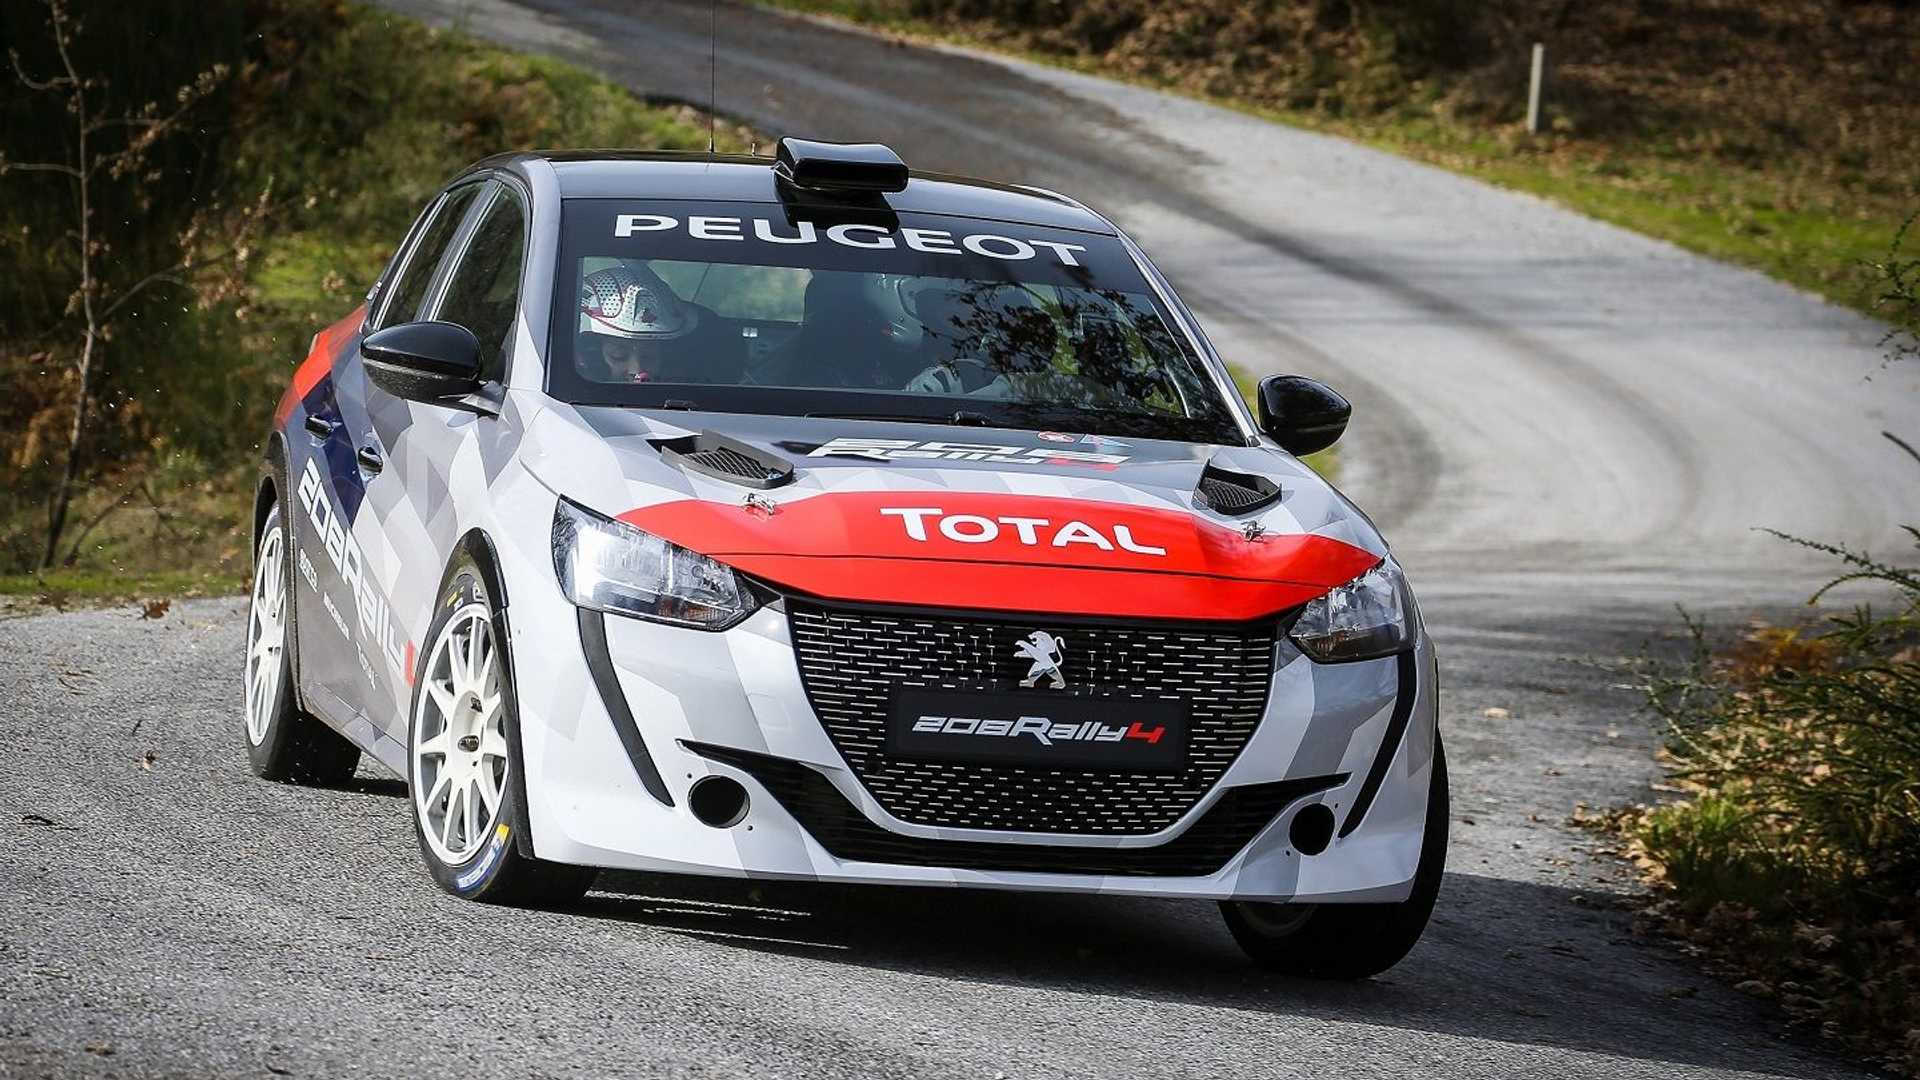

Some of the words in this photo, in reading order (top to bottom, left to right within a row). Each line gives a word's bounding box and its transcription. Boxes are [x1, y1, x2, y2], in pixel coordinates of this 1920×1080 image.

[614, 214, 1086, 266] PEUGEOT
[880, 508, 1167, 556] TOTAL
[912, 716, 1165, 745] 208Rally4
